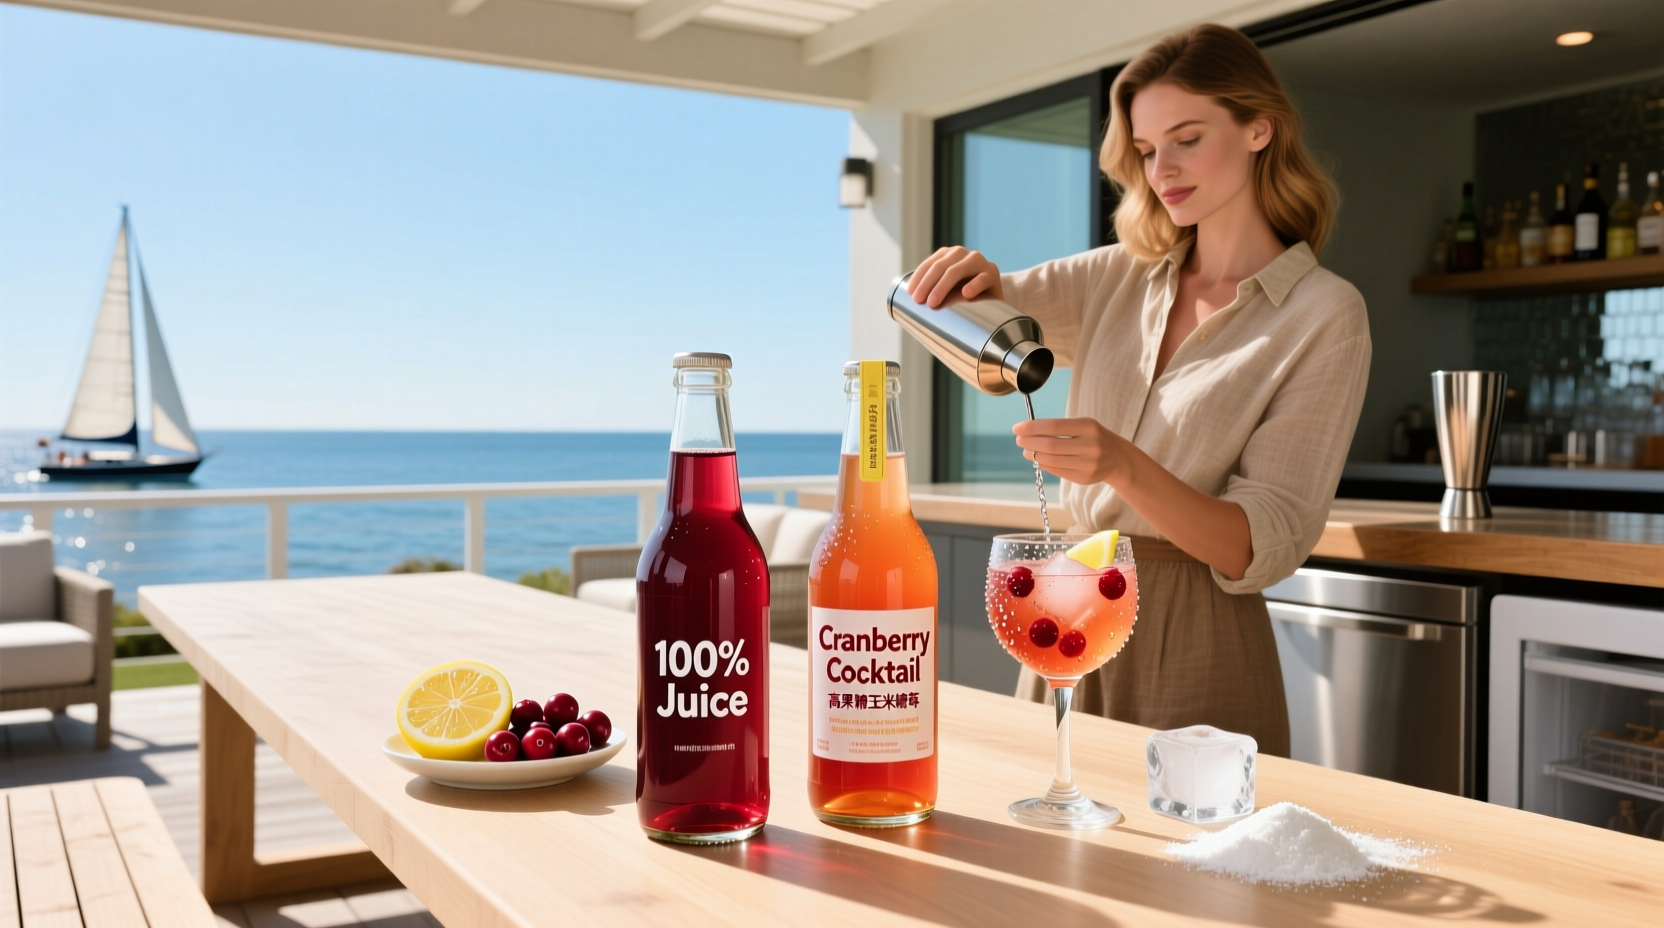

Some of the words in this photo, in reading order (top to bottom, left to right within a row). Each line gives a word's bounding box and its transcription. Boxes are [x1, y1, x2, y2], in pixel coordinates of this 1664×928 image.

[819, 624, 930, 657] Cranberry
[654, 638, 750, 678] 100%
[826, 655, 921, 684] Cocktail
[656, 682, 749, 718] Juice
